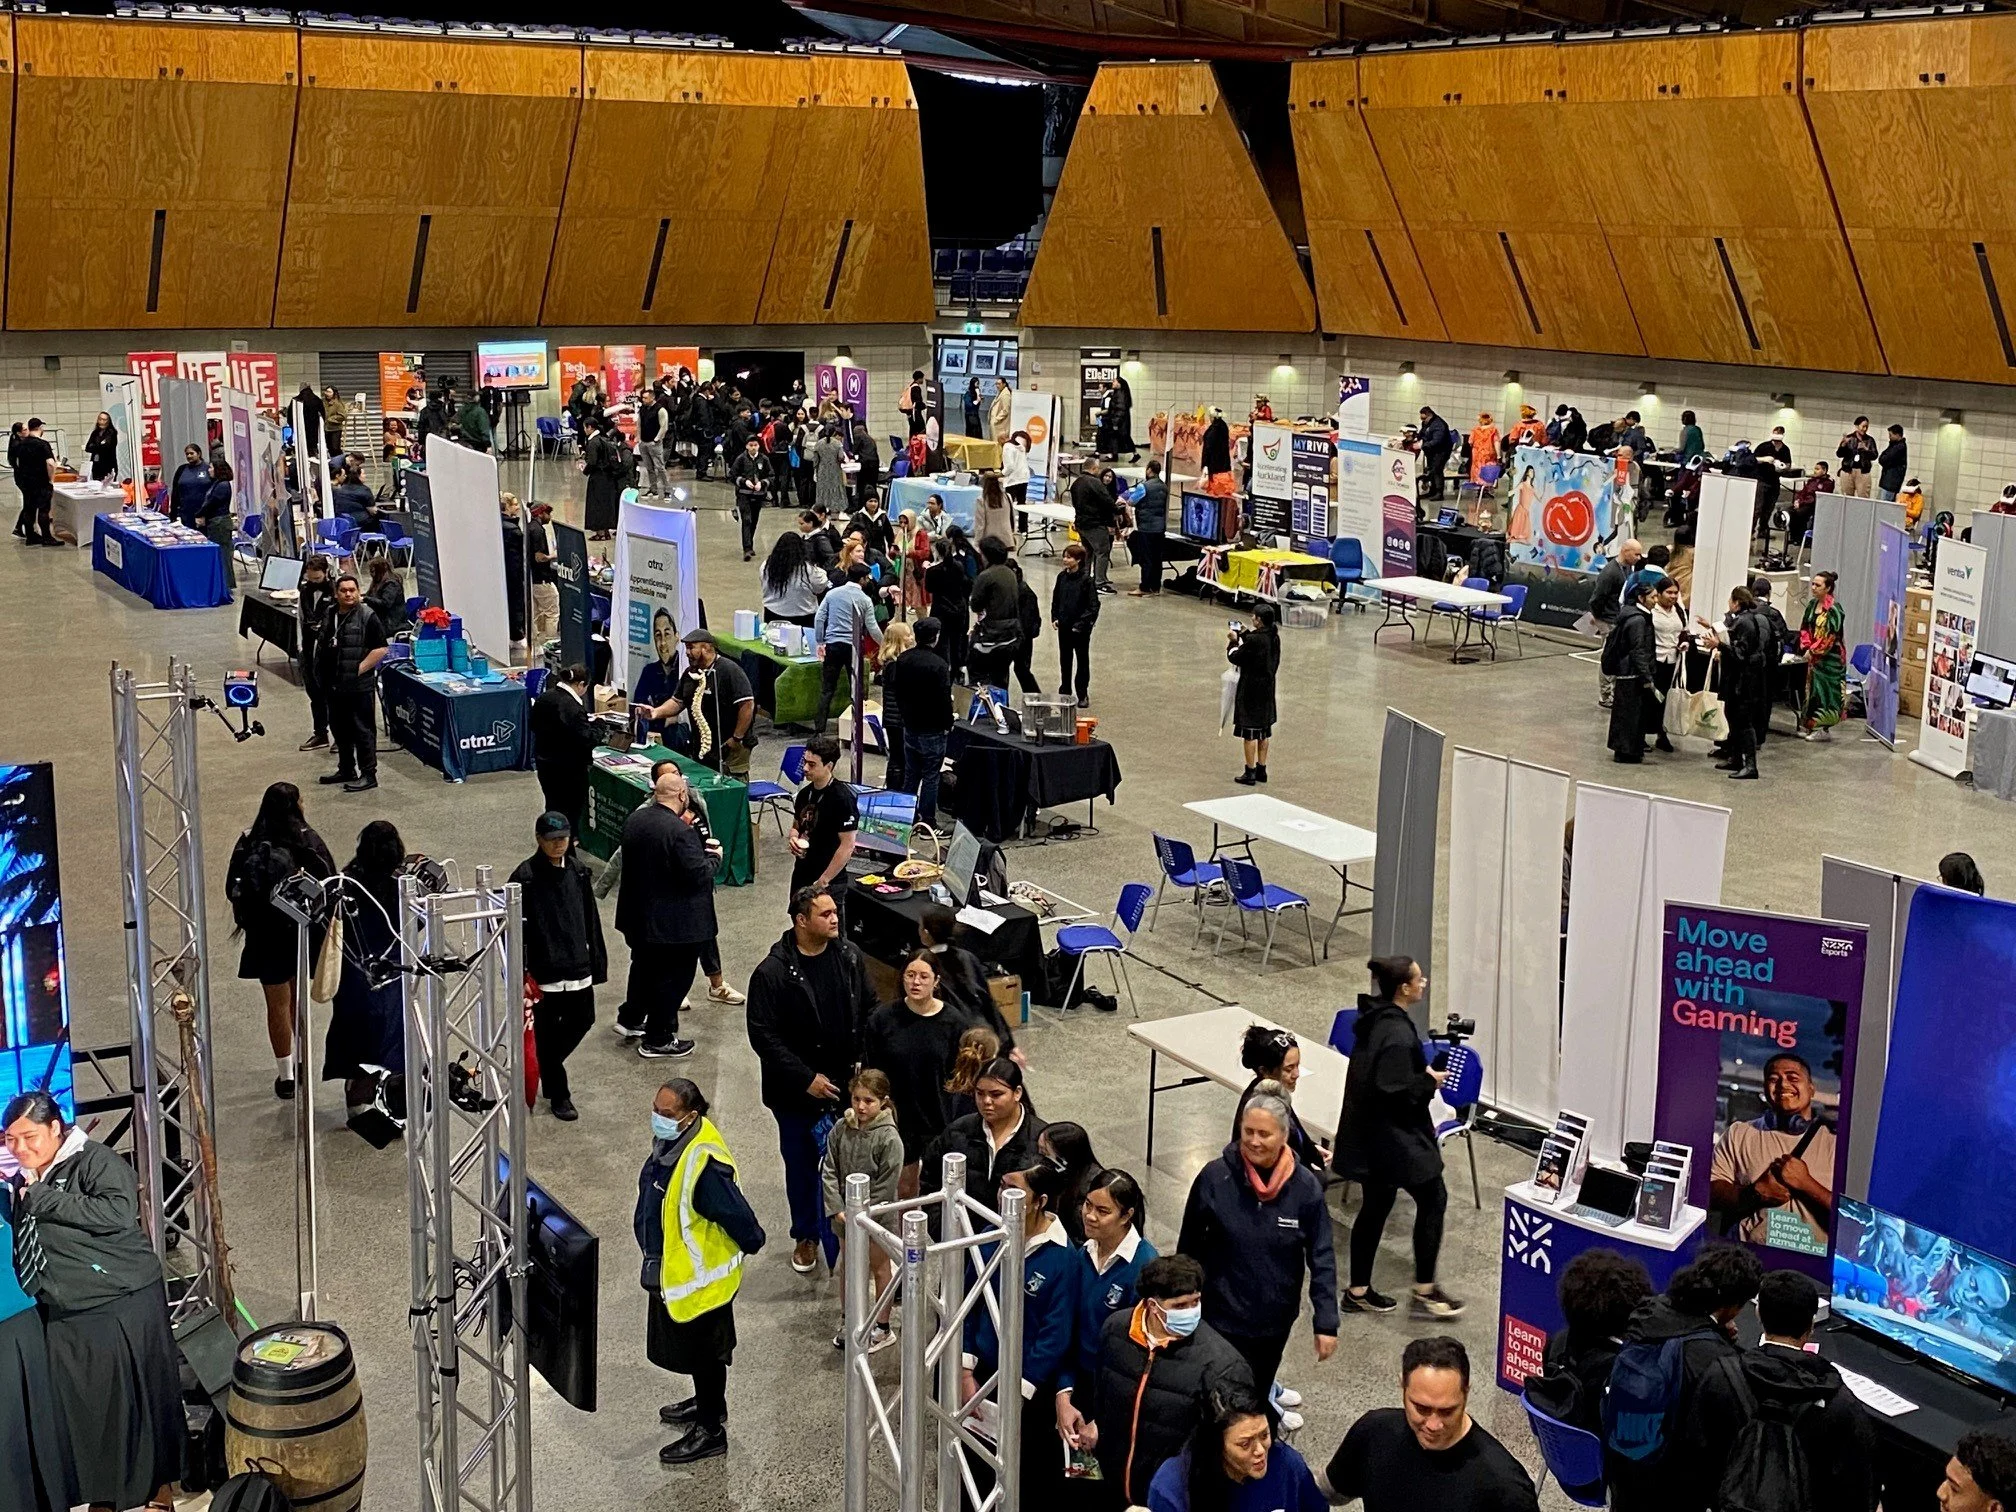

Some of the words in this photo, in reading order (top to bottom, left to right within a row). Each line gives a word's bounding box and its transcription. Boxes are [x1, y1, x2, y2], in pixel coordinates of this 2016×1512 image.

[849, 378, 858, 392] M
[1294, 439, 1329, 454] MYRIVR
[647, 559, 664, 571] atnz
[460, 734, 496, 749] atnz
[1677, 917, 1768, 954] Move
[1820, 947, 1849, 957] Esports
[1675, 947, 1774, 983] ahead
[1674, 975, 1744, 1006] with
[1672, 999, 1799, 1049] Gaming
[1770, 1211, 1798, 1224] Learn
[1770, 1220, 1780, 1229] to
[1783, 1224, 1810, 1235] move
[1769, 1229, 1800, 1242] ahead
[1768, 1237, 1825, 1254] nzma.ac.nz
[1508, 1320, 1542, 1348] Learn
[1507, 1336, 1521, 1352] to
[1523, 1346, 1543, 1362] mo
